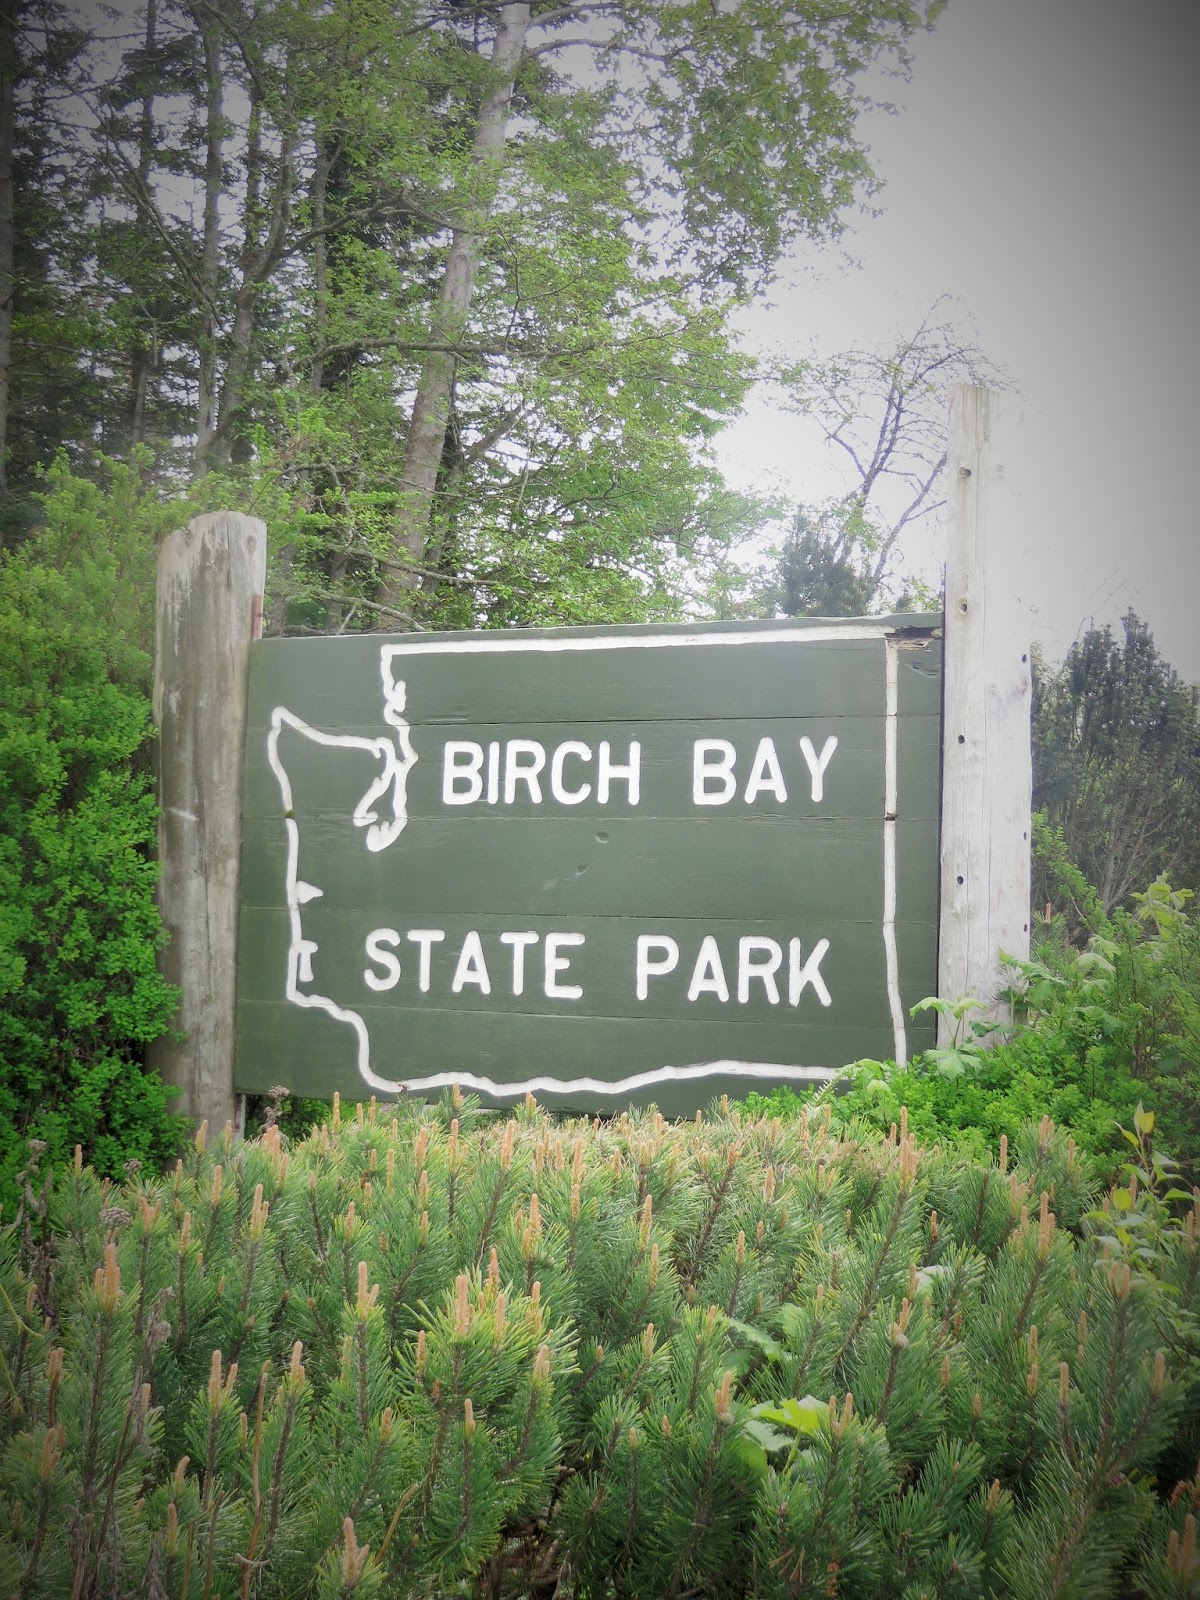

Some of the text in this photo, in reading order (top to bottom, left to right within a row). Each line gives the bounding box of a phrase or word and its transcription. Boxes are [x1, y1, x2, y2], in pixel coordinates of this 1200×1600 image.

[442, 735, 838, 806] BIRCH BAY
[364, 928, 833, 1007] STATE PARK
